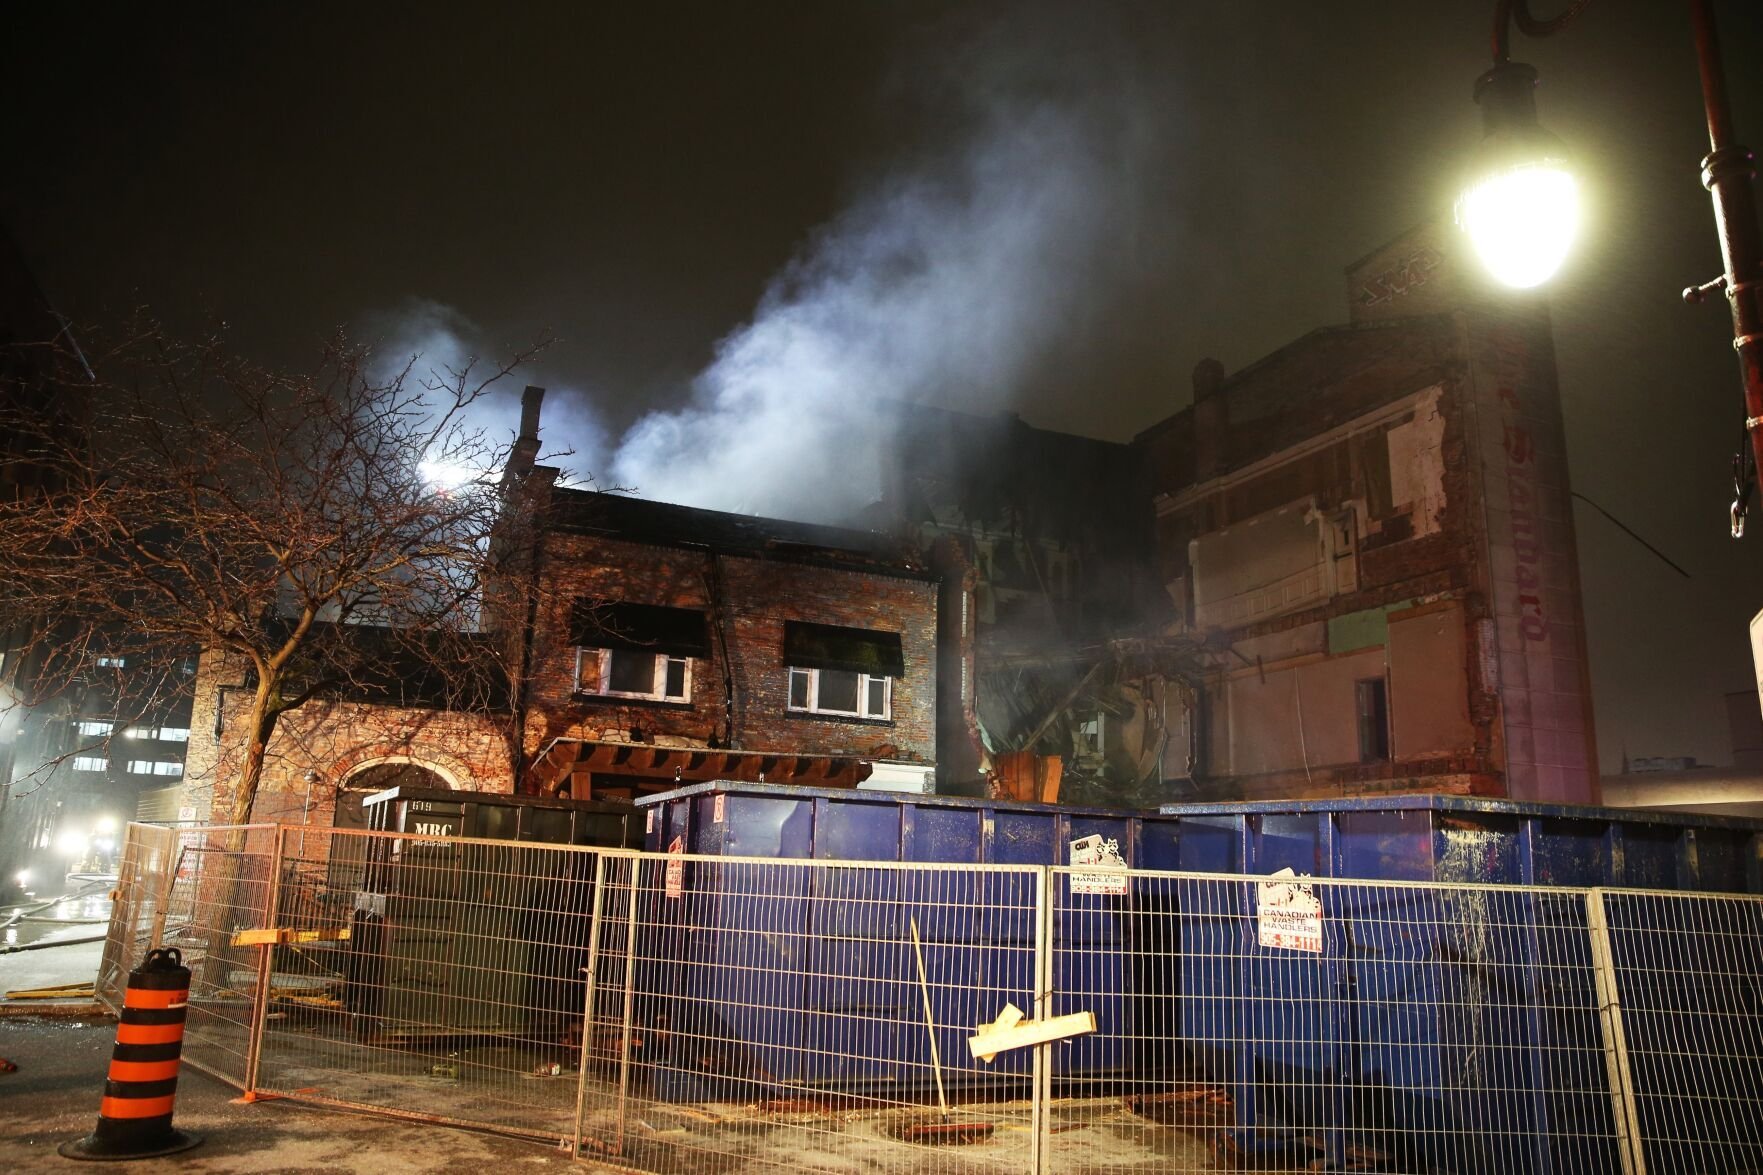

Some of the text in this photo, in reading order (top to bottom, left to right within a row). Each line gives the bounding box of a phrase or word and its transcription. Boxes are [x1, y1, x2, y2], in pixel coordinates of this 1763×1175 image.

[1263, 909, 1318, 919] CANADIAN
[1272, 917, 1307, 926] WASTE
[1263, 922, 1318, 933] HANDLERS
